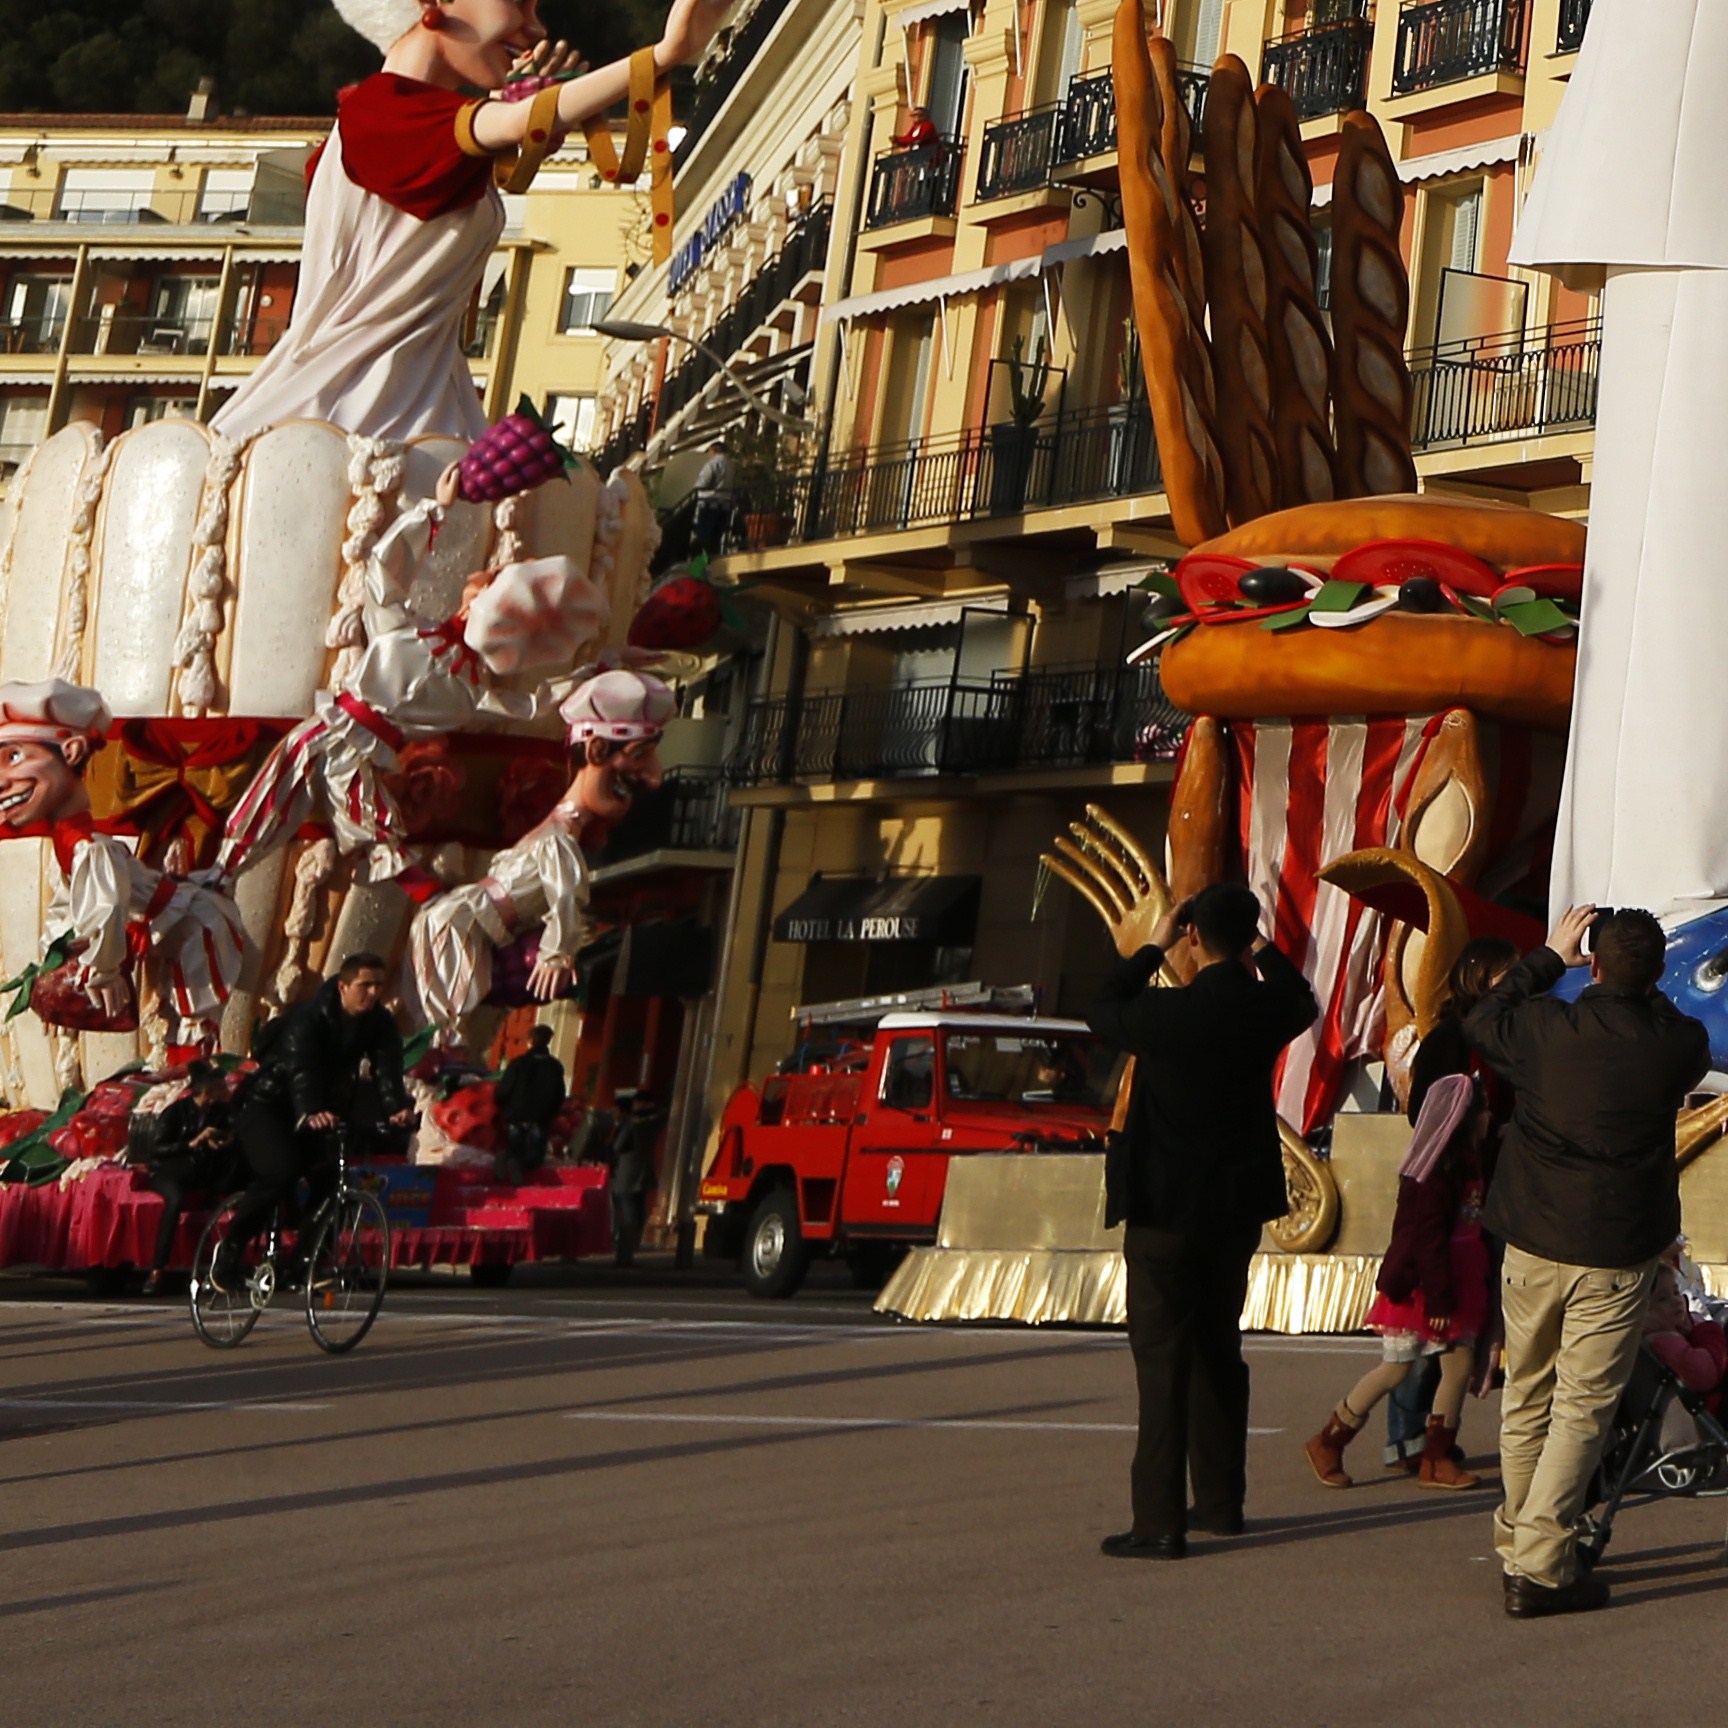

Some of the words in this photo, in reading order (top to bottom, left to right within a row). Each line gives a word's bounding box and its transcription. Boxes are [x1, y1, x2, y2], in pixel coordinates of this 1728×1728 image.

[788, 919, 830, 940] HOTEL
[837, 918, 854, 940] LA
[860, 916, 919, 940] PEROUSE
